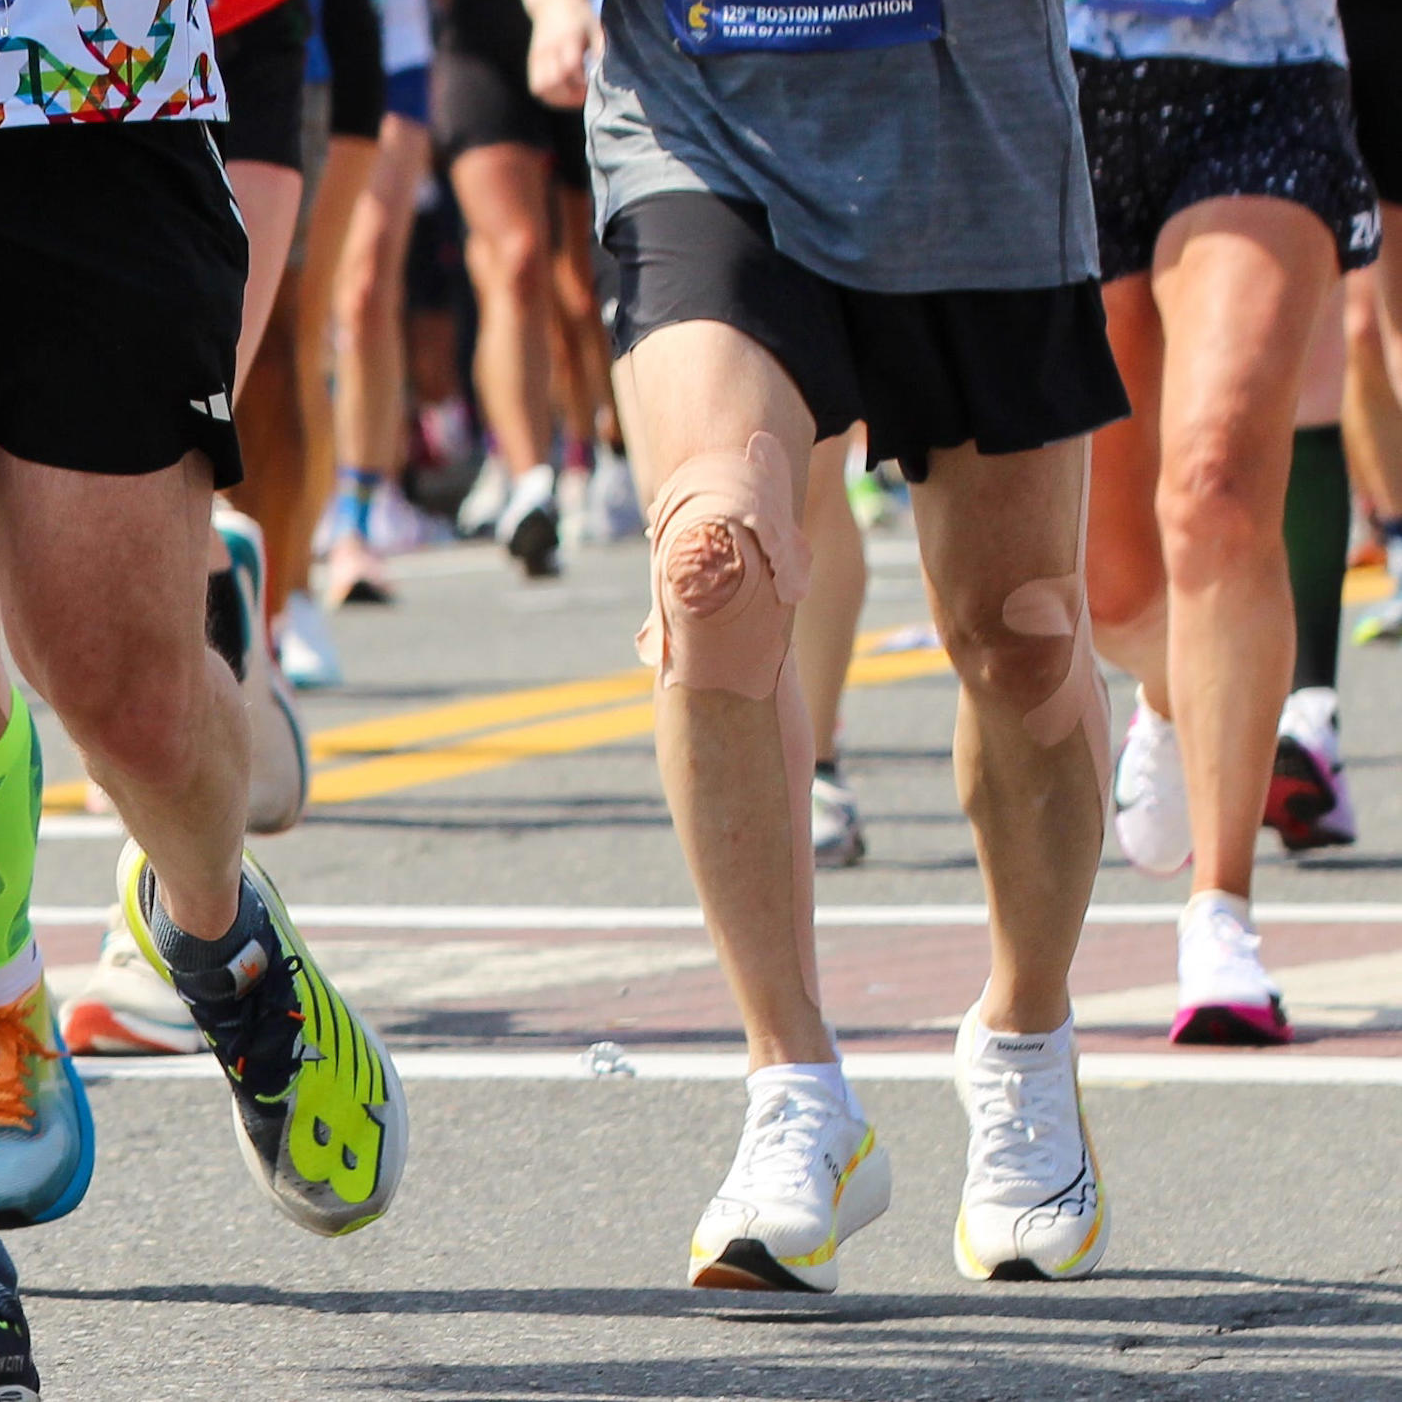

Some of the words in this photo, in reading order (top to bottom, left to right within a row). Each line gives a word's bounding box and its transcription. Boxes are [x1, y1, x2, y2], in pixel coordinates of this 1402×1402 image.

[722, 5, 755, 24] 129TH
[756, 4, 819, 24] BOSTON
[722, 26, 756, 38] BANK
[758, 26, 772, 38] OF
[775, 24, 833, 37] AMERICA
